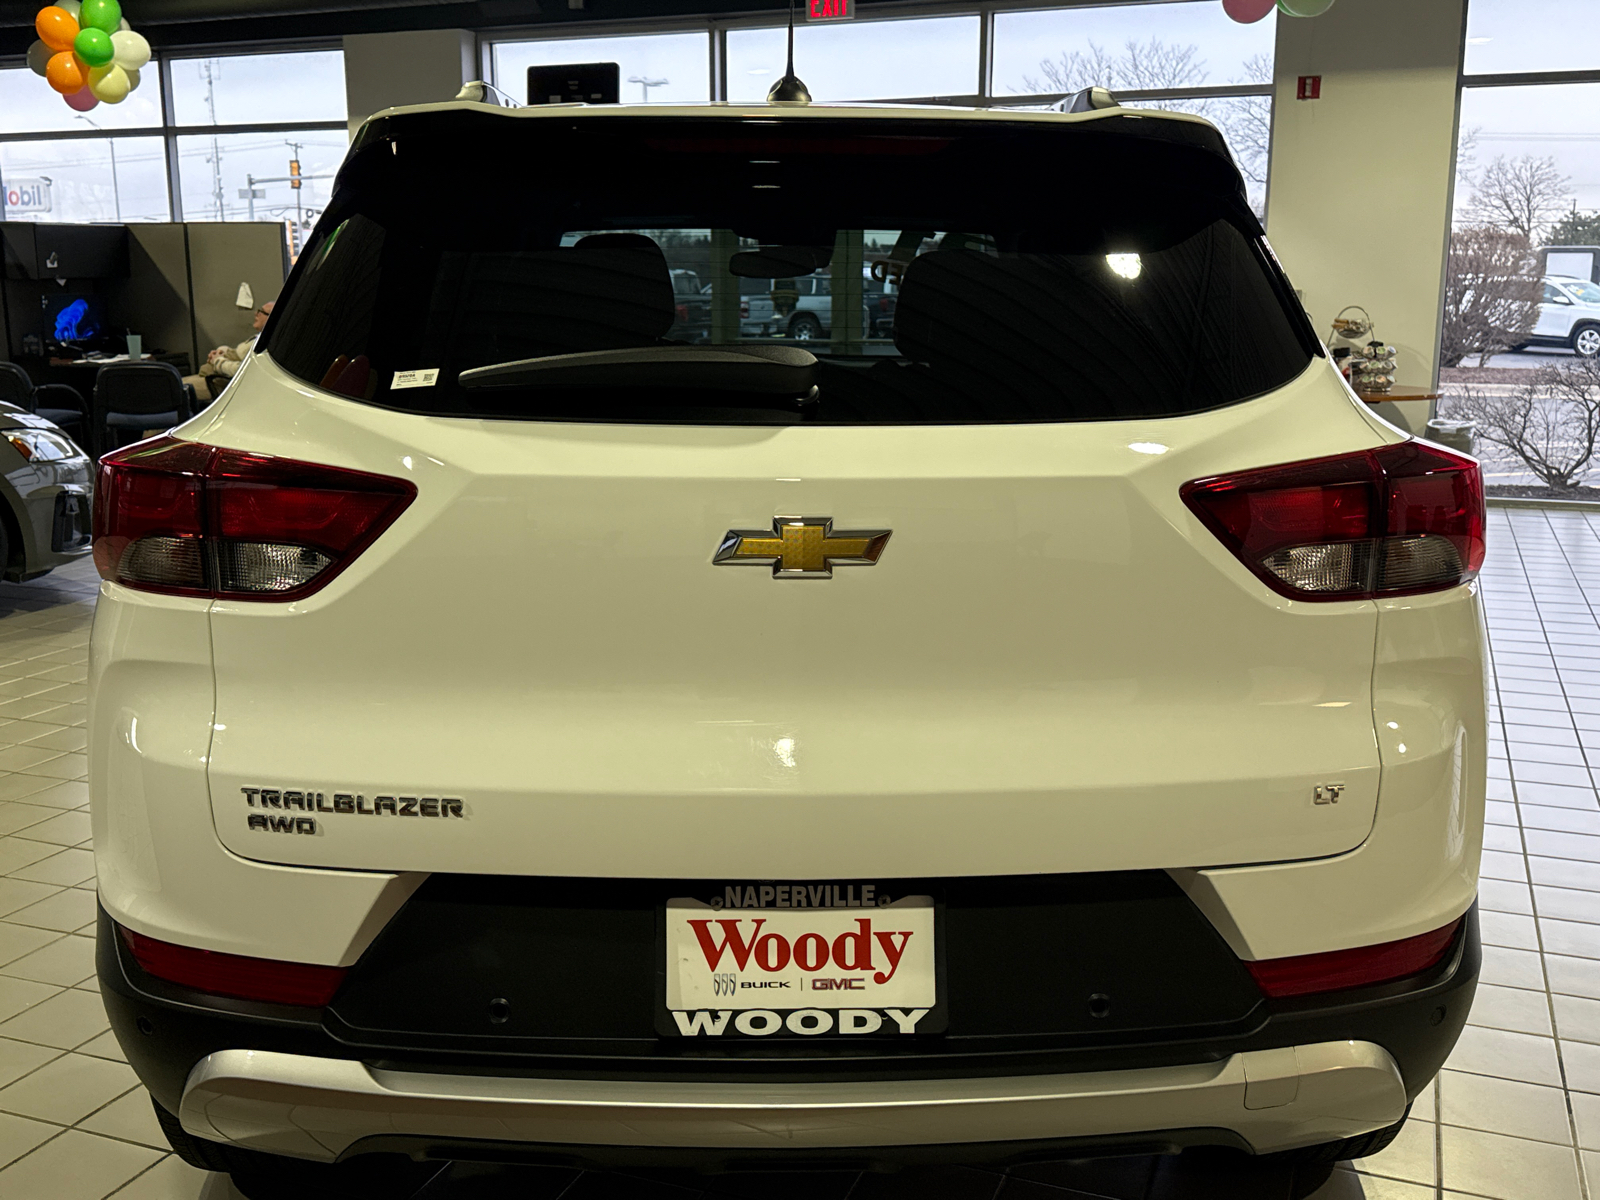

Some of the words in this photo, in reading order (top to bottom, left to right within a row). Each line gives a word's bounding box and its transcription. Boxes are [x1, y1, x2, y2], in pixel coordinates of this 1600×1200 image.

[241, 787, 464, 818] TRAILBLAZER
[1314, 785, 1346, 805] LT
[248, 813, 316, 835] AWD
[725, 885, 876, 908] NAPERVILLE
[687, 918, 914, 985] Woody
[740, 980, 792, 989] BUICK
[811, 977, 866, 991] GMC
[671, 1008, 930, 1037] WOODY
